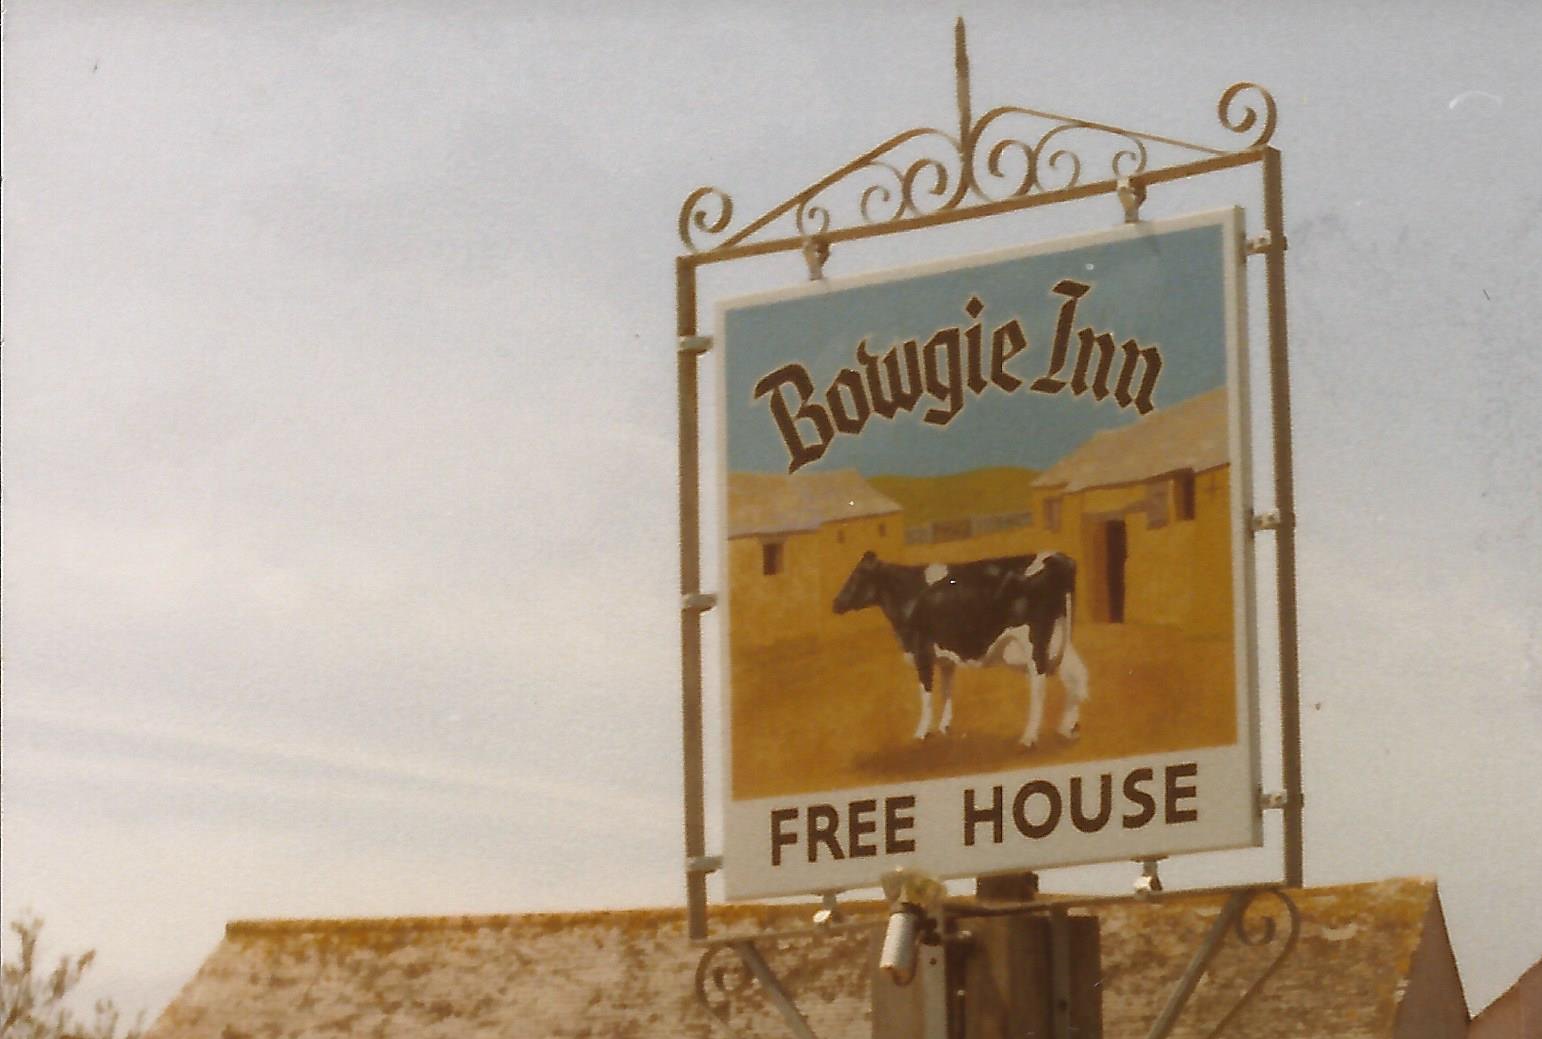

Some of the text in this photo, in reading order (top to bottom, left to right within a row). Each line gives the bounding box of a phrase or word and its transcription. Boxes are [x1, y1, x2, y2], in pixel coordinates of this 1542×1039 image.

[753, 279, 1164, 474] Bowgie Inn
[770, 762, 1198, 867] FREE HOUSE
